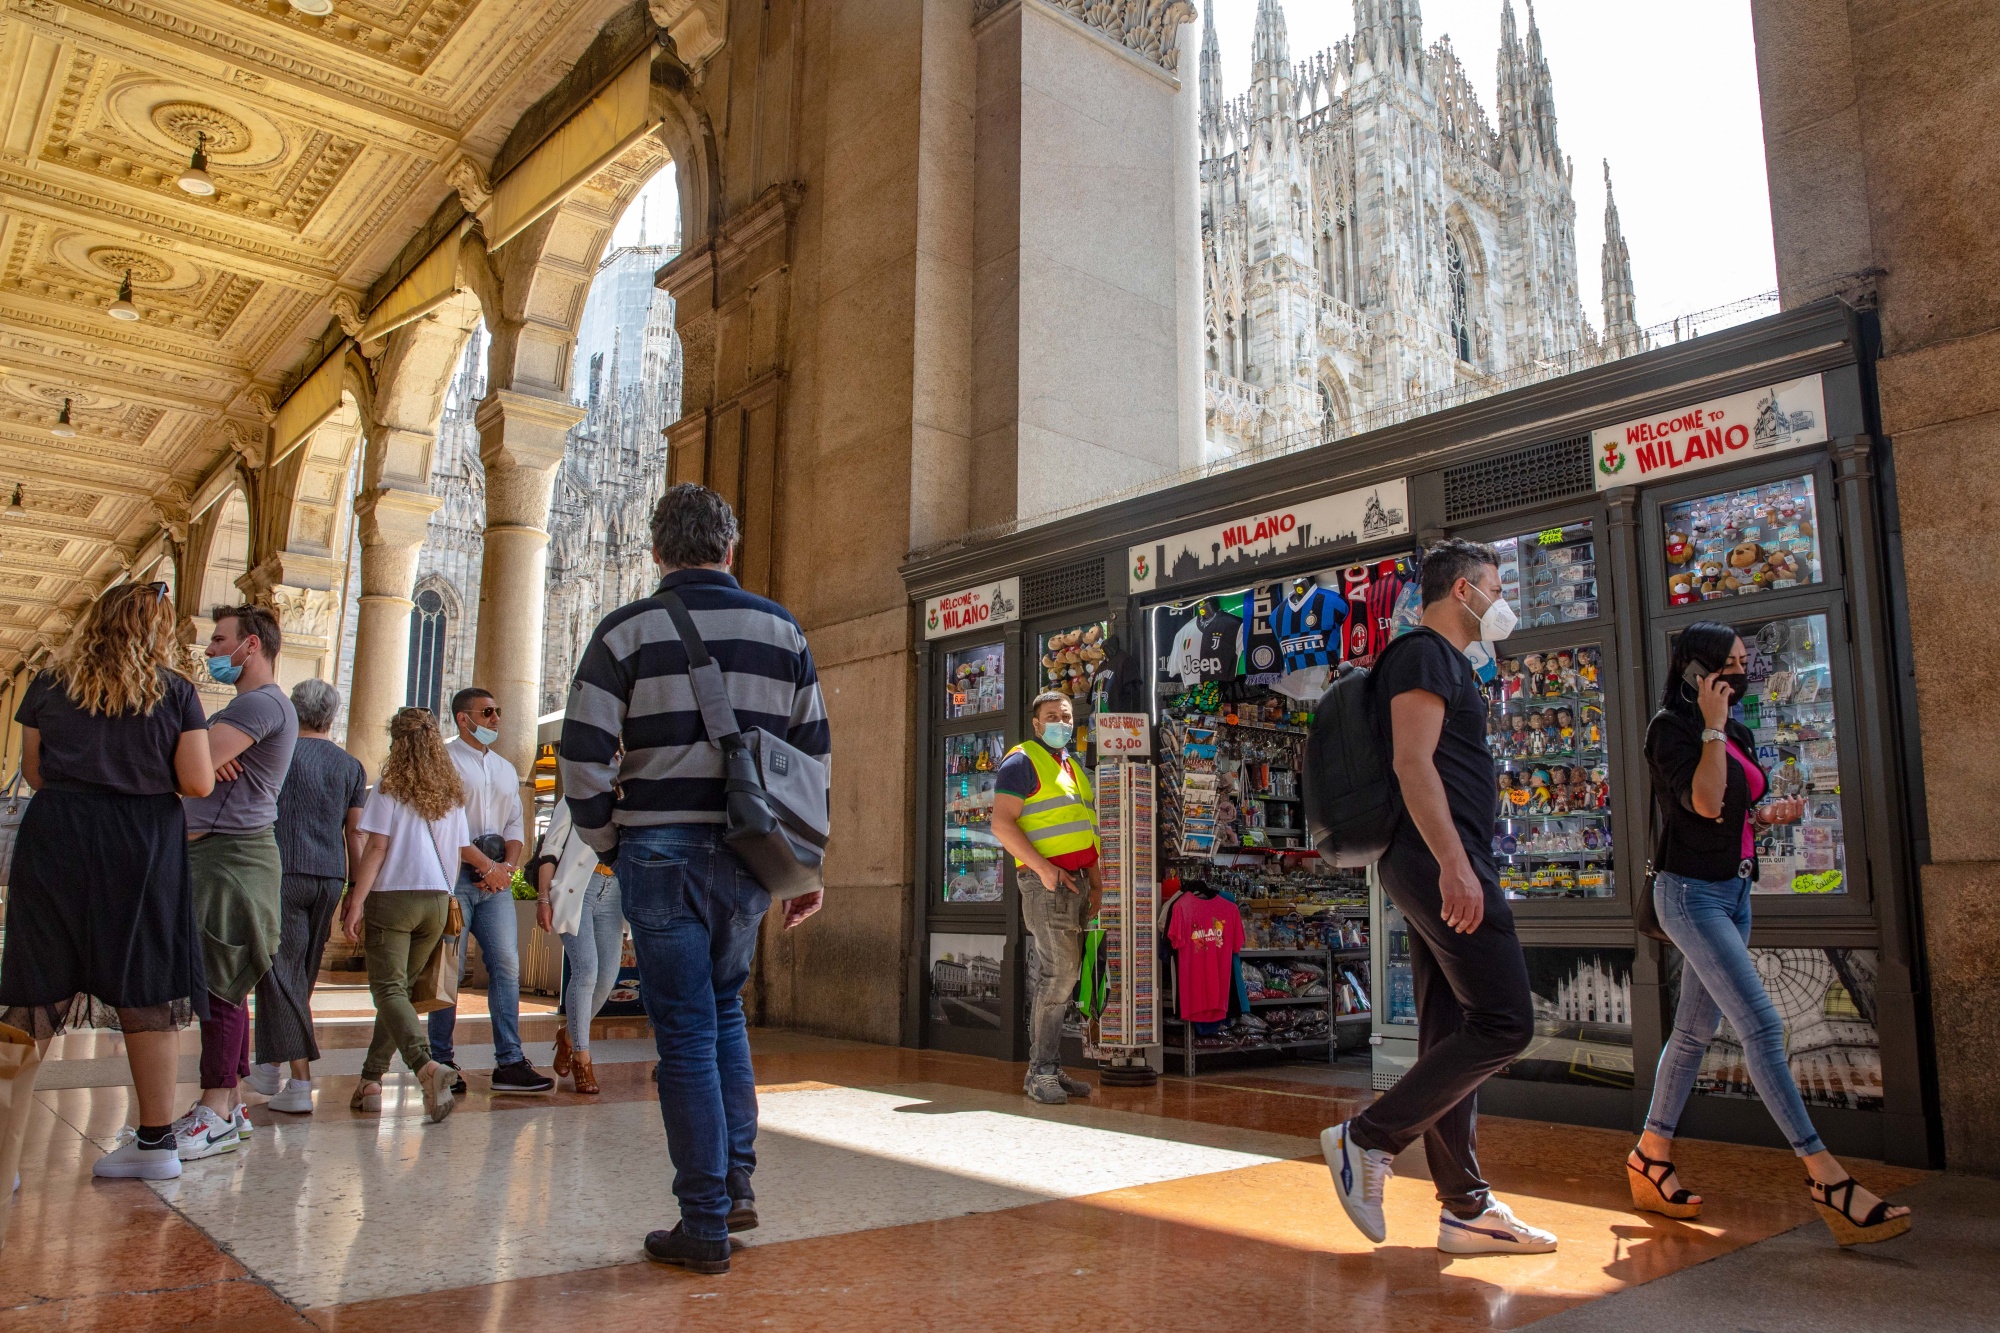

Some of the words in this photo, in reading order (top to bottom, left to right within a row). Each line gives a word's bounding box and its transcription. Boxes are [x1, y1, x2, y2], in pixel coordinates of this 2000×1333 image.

[1626, 409, 1704, 445] WELCOME
[1708, 410, 1725, 422] TO
[1635, 424, 1749, 474] MILANO
[1222, 513, 1296, 549] MILANO
[940, 592, 972, 611] WELCOME
[943, 603, 989, 631] MILANO
[1184, 655, 1222, 675] Jeep
[1099, 718, 1108, 727] NO
[1103, 739, 1112, 748] €
[1115, 737, 1142, 751] 3,00
